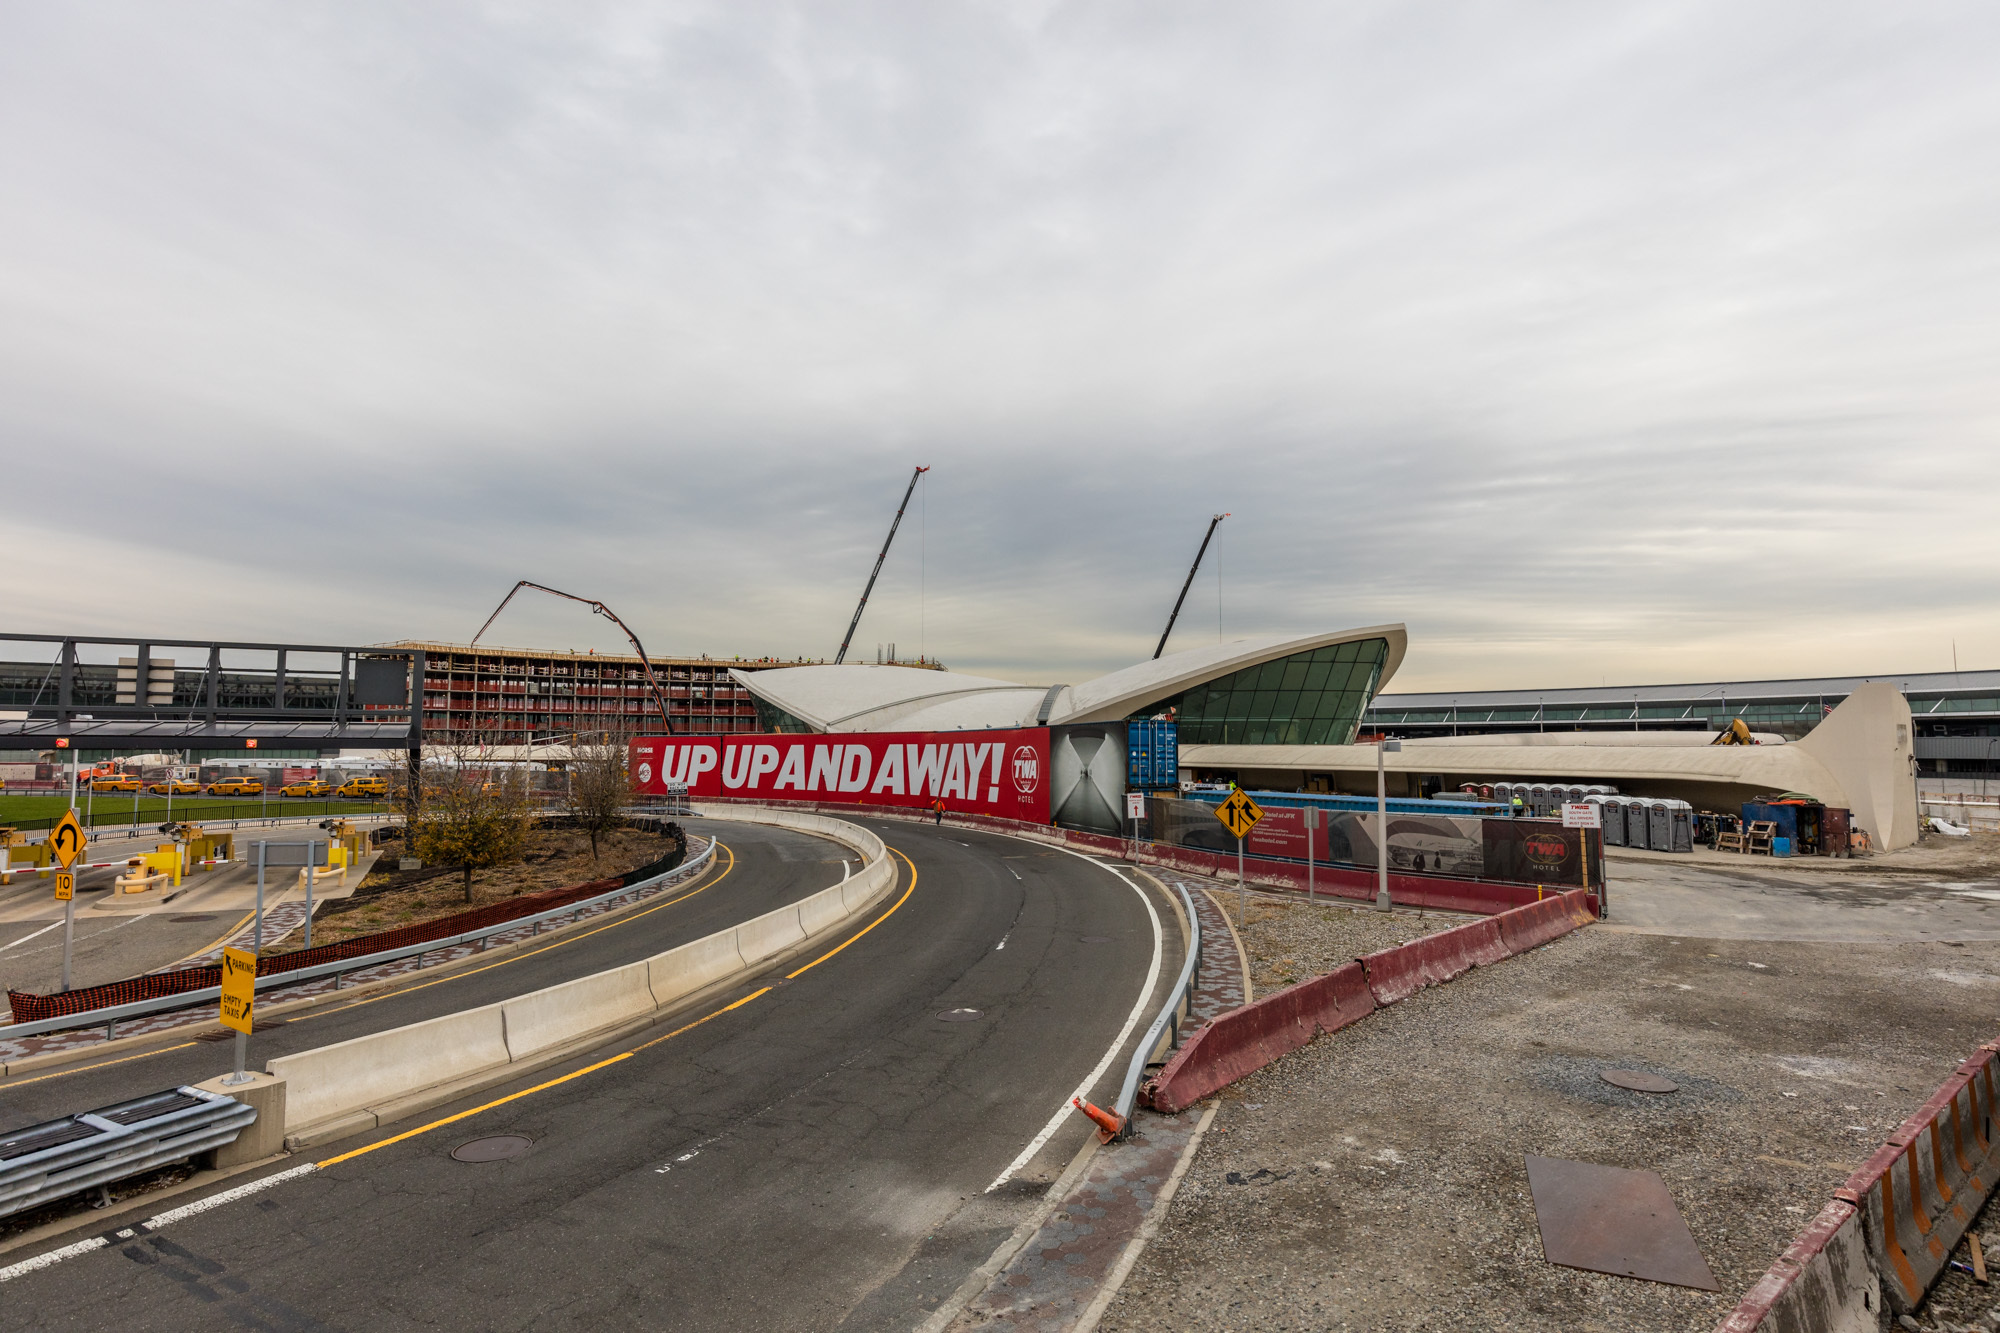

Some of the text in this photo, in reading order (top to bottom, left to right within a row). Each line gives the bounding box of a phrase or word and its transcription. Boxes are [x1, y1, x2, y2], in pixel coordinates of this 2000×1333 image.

[661, 742, 1006, 803] UP UP AND AWAY!
[1014, 759, 1037, 779] TWA
[1017, 795, 1034, 804] HOTEL
[1526, 842, 1565, 856] TWA
[1532, 864, 1561, 872] HOTEL
[58, 876, 70, 890] 10
[232, 958, 254, 974] PARKING
[223, 993, 241, 1008] EMPTY
[224, 1005, 240, 1019] TAXIS
